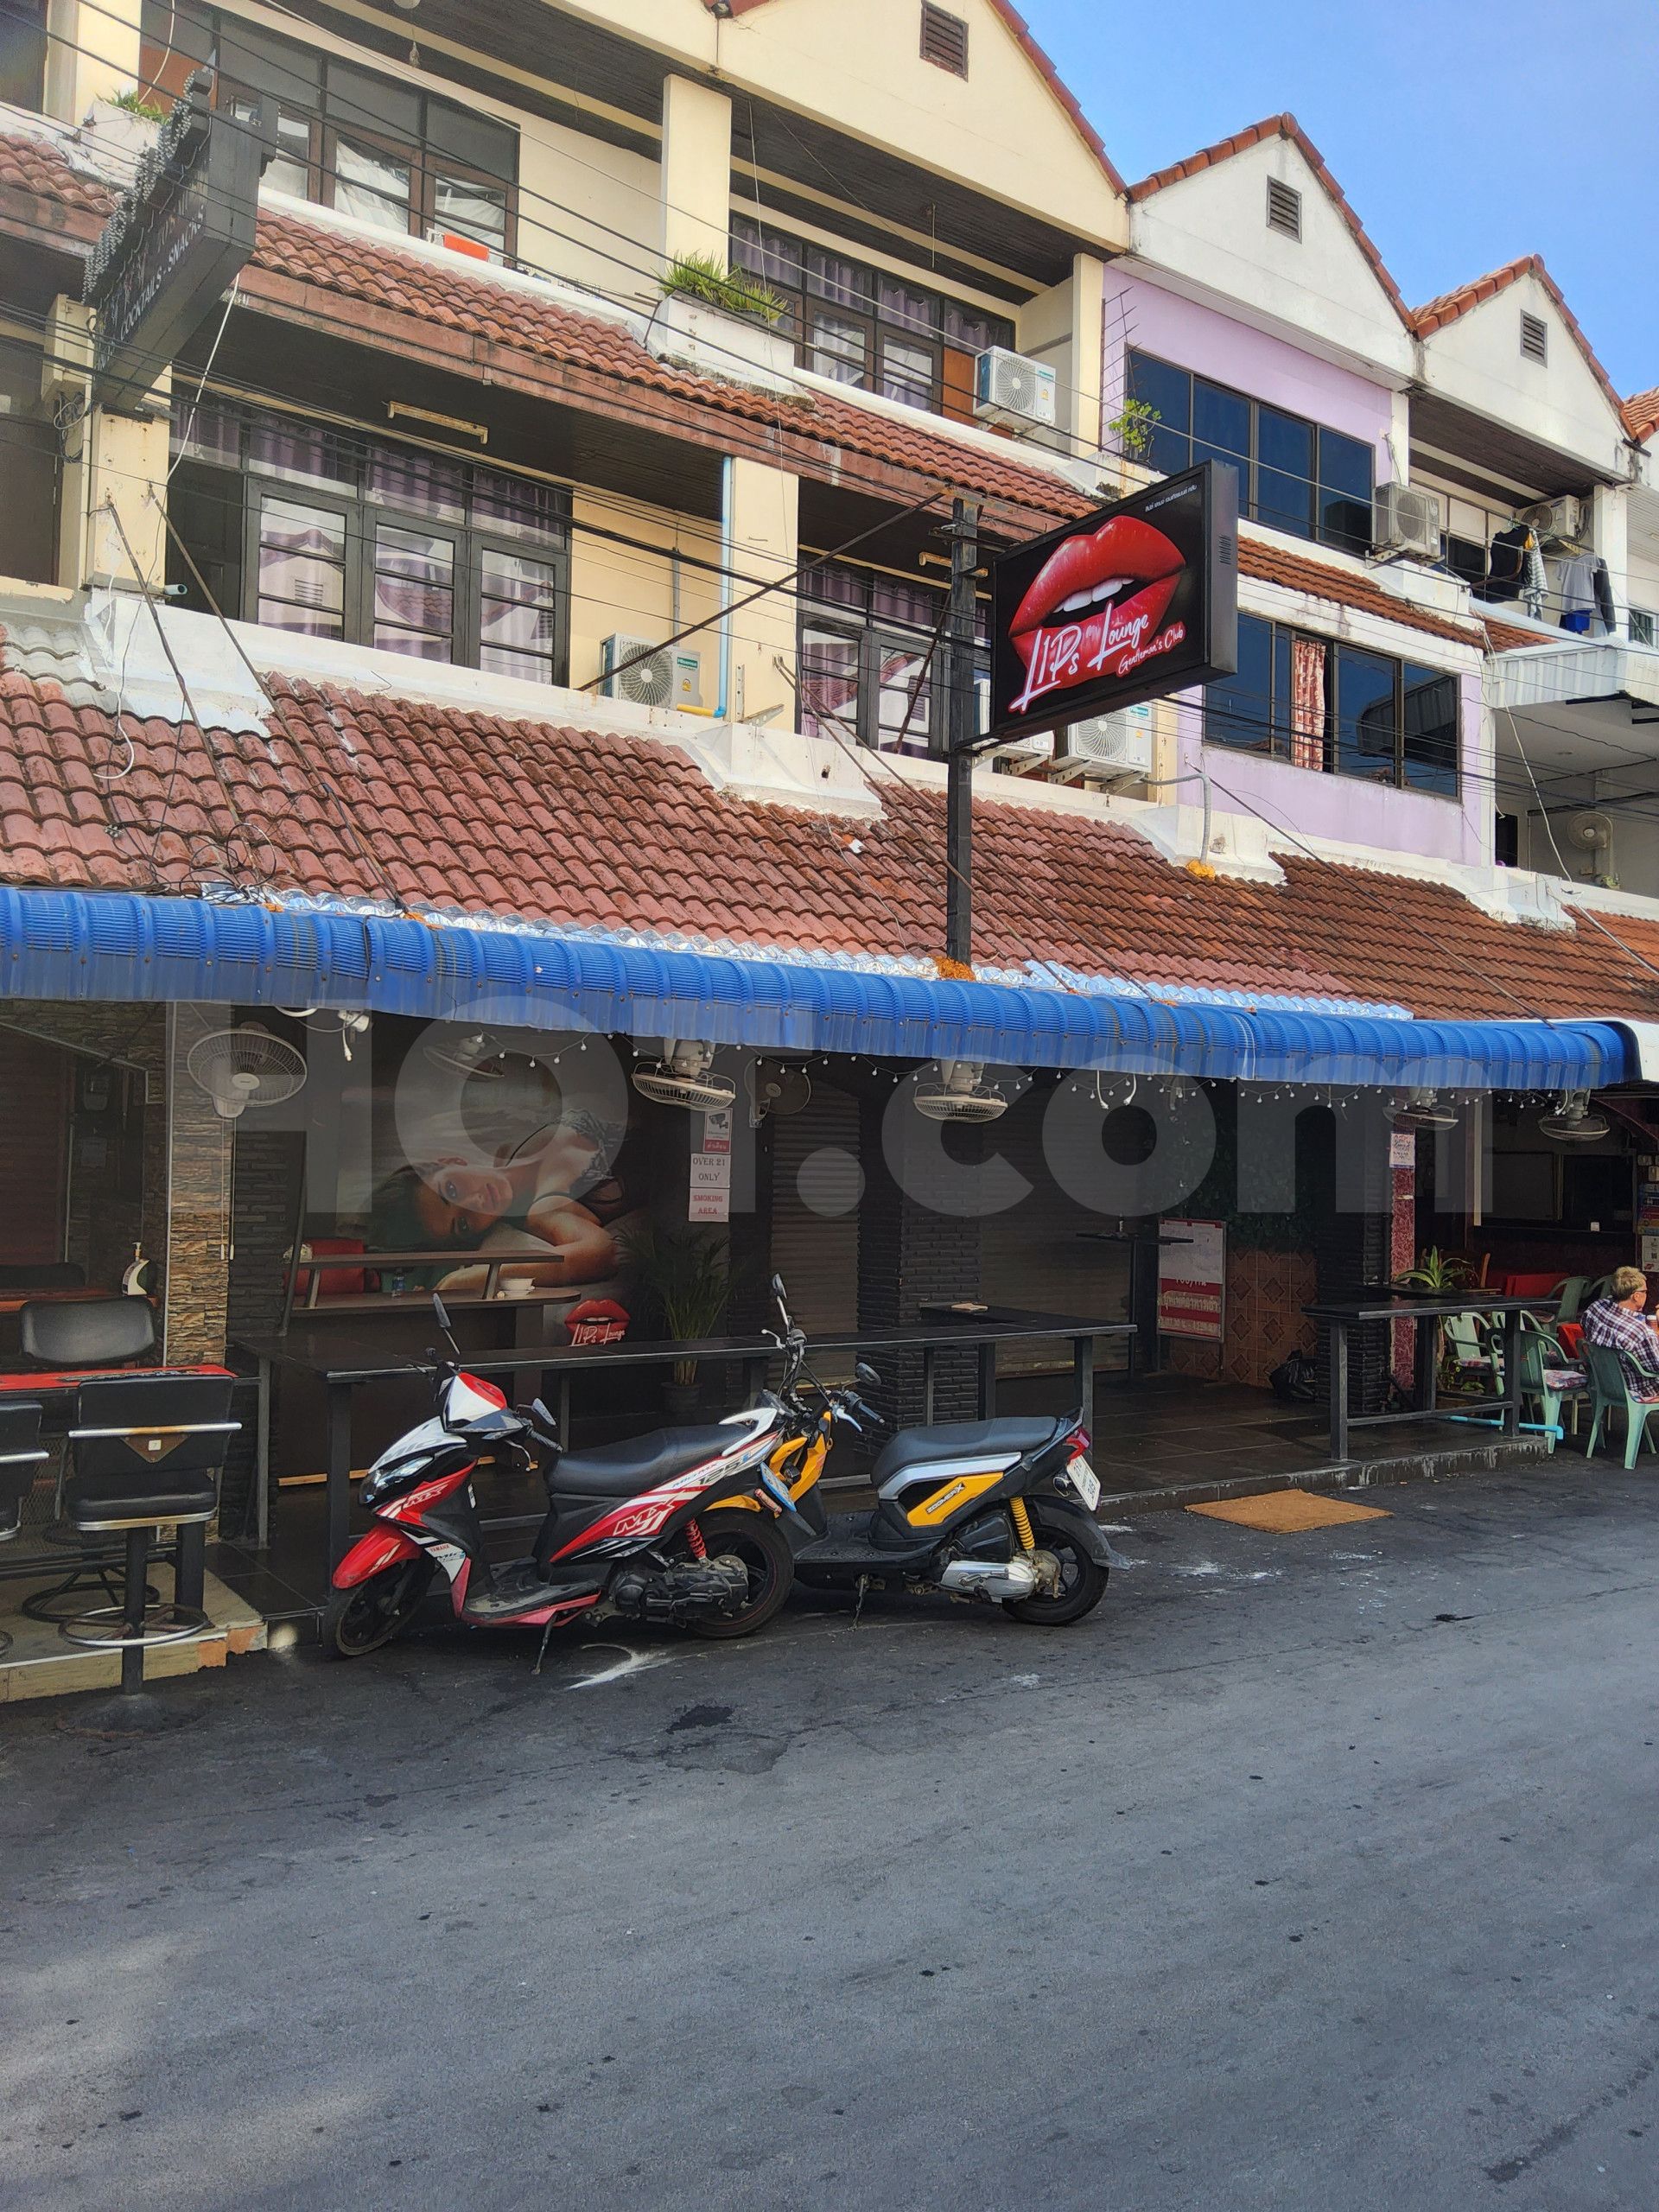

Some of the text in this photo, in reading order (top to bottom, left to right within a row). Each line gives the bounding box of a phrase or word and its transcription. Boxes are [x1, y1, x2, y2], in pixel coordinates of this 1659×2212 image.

[1087, 601, 1149, 671] Lounge
[1118, 624, 1184, 675] Gentleman's Club
[692, 1157, 726, 1166] OVER 21
[698, 1172, 721, 1181] ONLY
[693, 1194, 723, 1203] SMOKING
[600, 1322, 626, 1345] Lounge
[429, 1544, 450, 1553] YAMAHA
